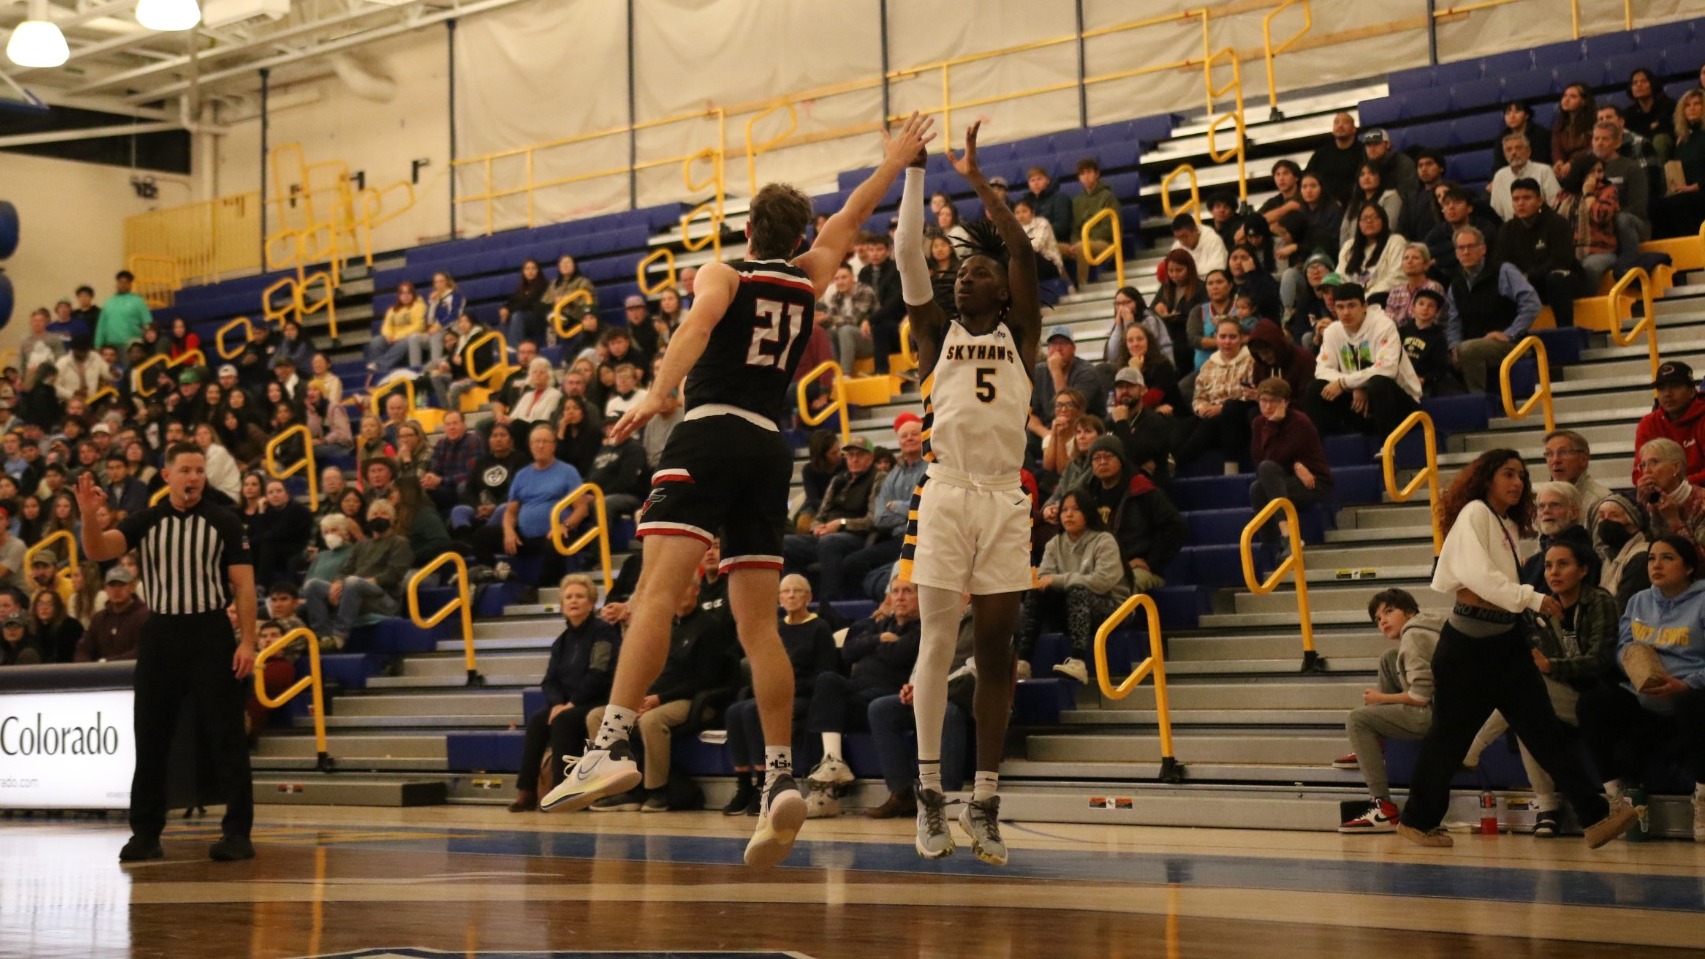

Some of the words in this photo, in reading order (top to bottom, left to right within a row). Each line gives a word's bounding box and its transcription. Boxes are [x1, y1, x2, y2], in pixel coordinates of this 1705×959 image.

[745, 298, 805, 371] 21
[946, 344, 1014, 364] SKYHAWS
[976, 367, 997, 403] 5
[0, 711, 119, 756] Colorado
